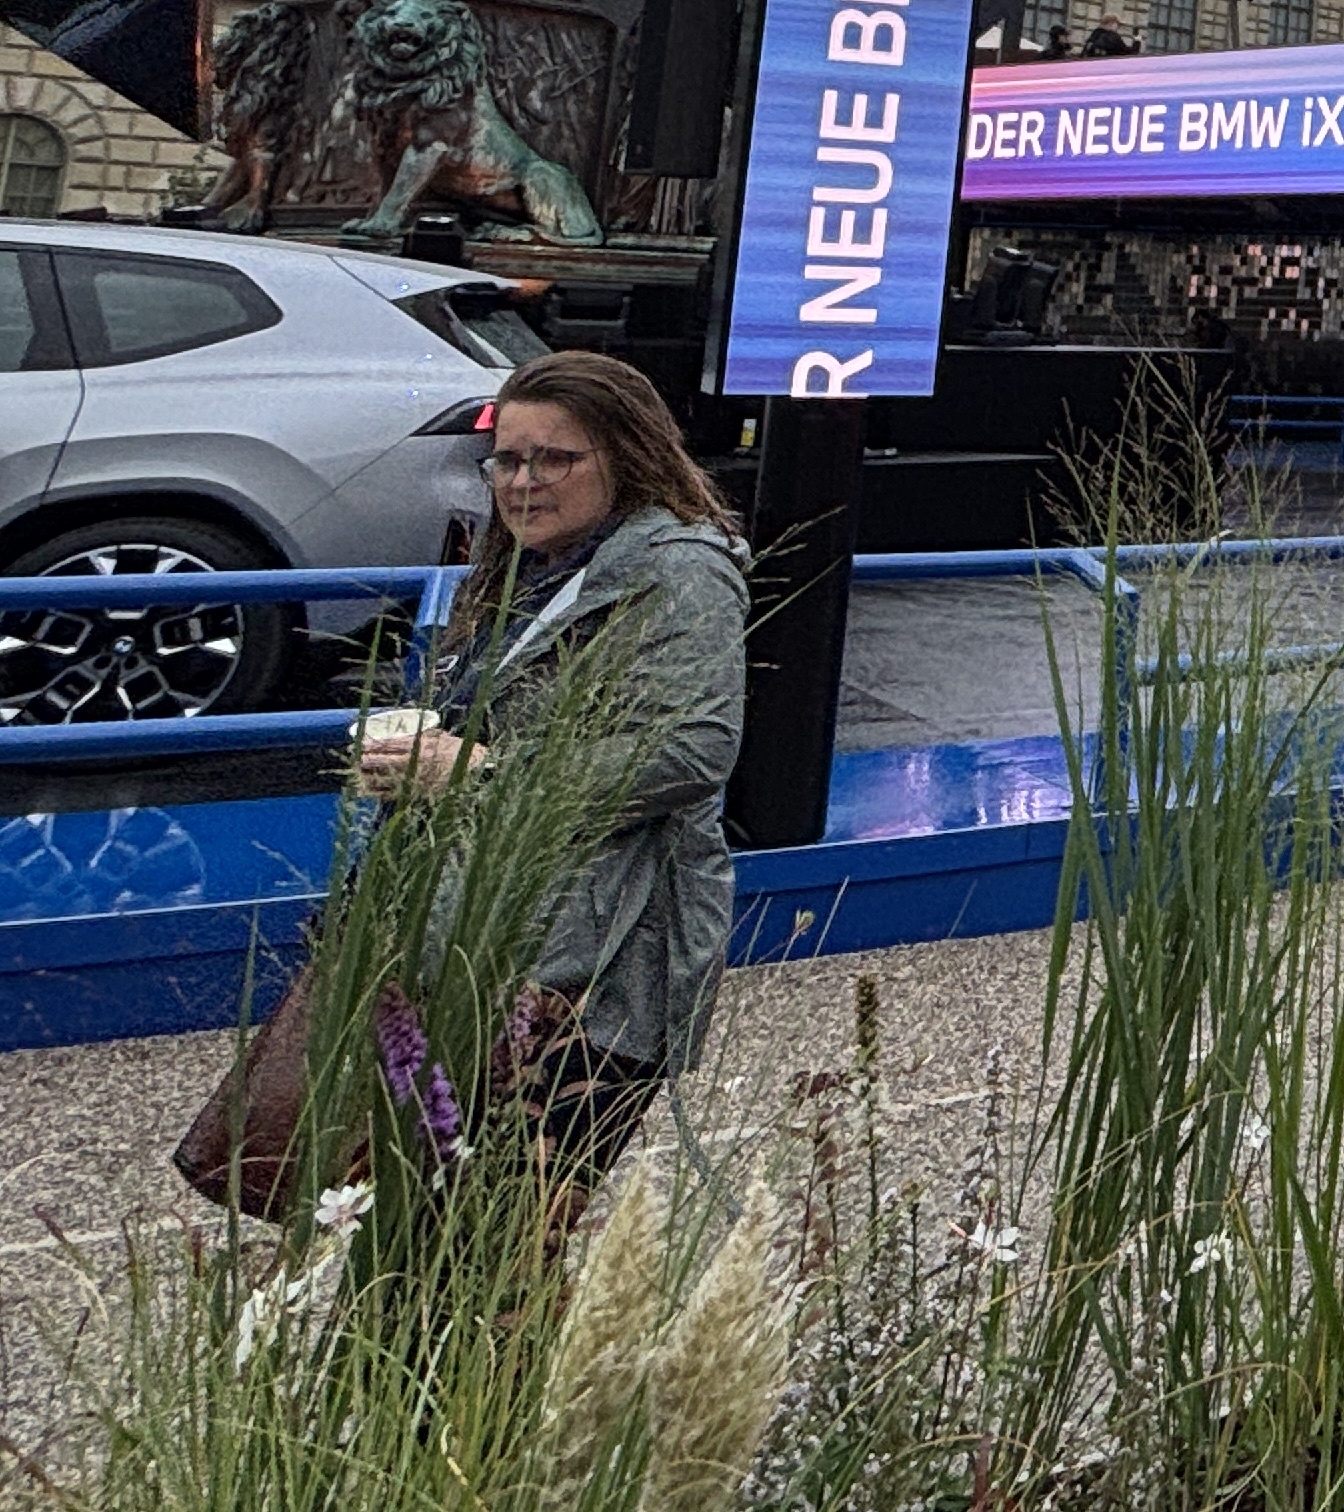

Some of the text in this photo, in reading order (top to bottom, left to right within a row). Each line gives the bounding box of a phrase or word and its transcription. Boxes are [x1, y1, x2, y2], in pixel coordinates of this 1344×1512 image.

[966, 110, 1044, 159] DER
[1056, 104, 1168, 156] NEUE
[1179, 98, 1290, 152] BMW
[799, 89, 900, 323] NEUE
[790, 349, 874, 400] R
